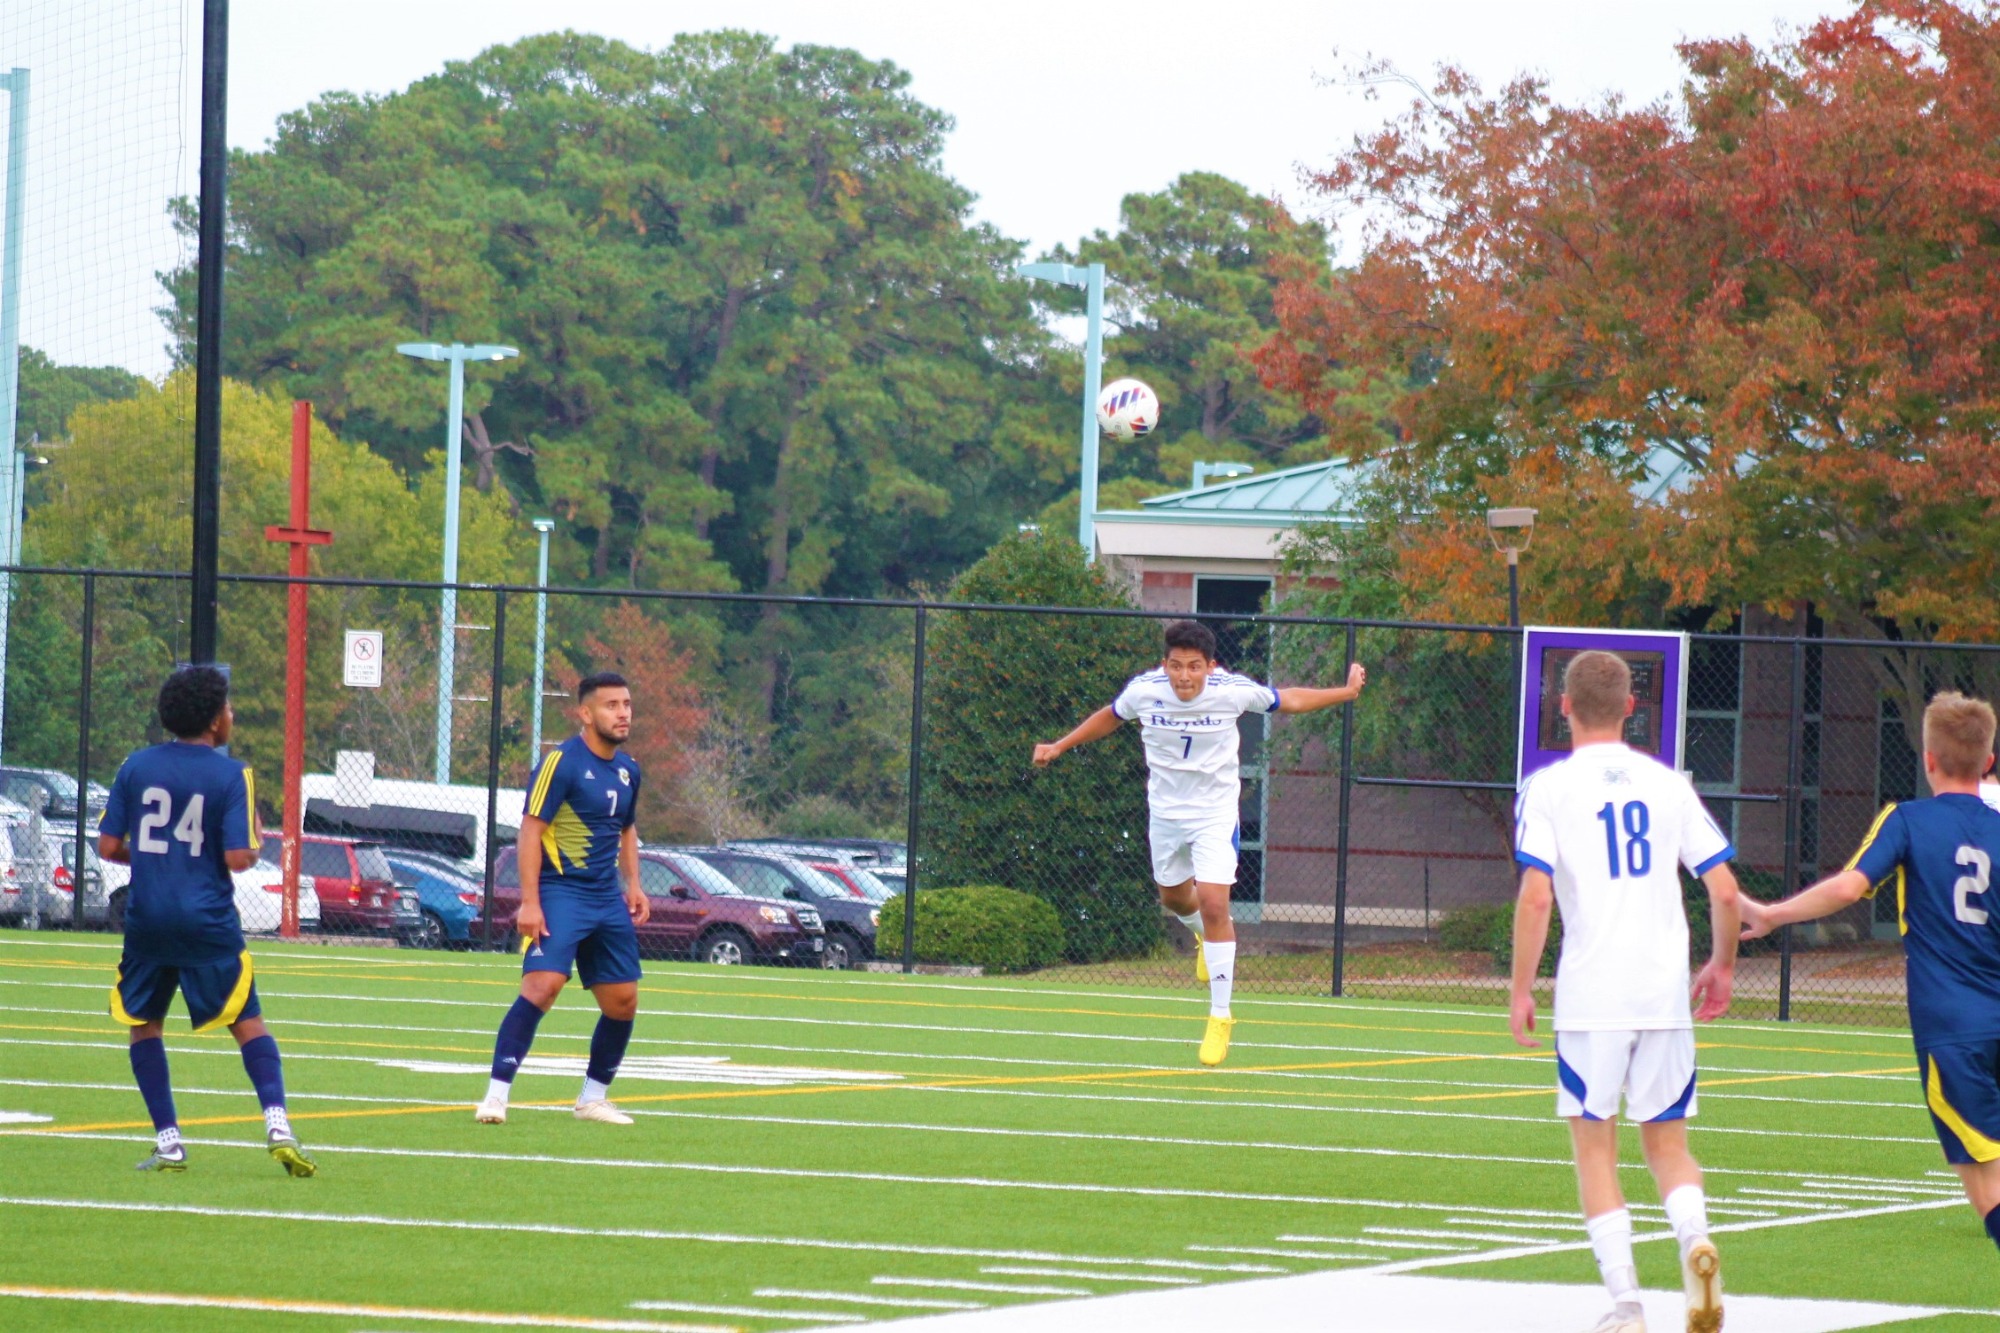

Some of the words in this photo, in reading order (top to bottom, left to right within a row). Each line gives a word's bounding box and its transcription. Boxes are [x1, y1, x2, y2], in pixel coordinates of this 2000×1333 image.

[1180, 736, 1192, 759] 7
[138, 787, 204, 857] 24
[607, 790, 617, 816] 7
[1598, 800, 1650, 880] 18
[1954, 845, 1990, 925] 2
